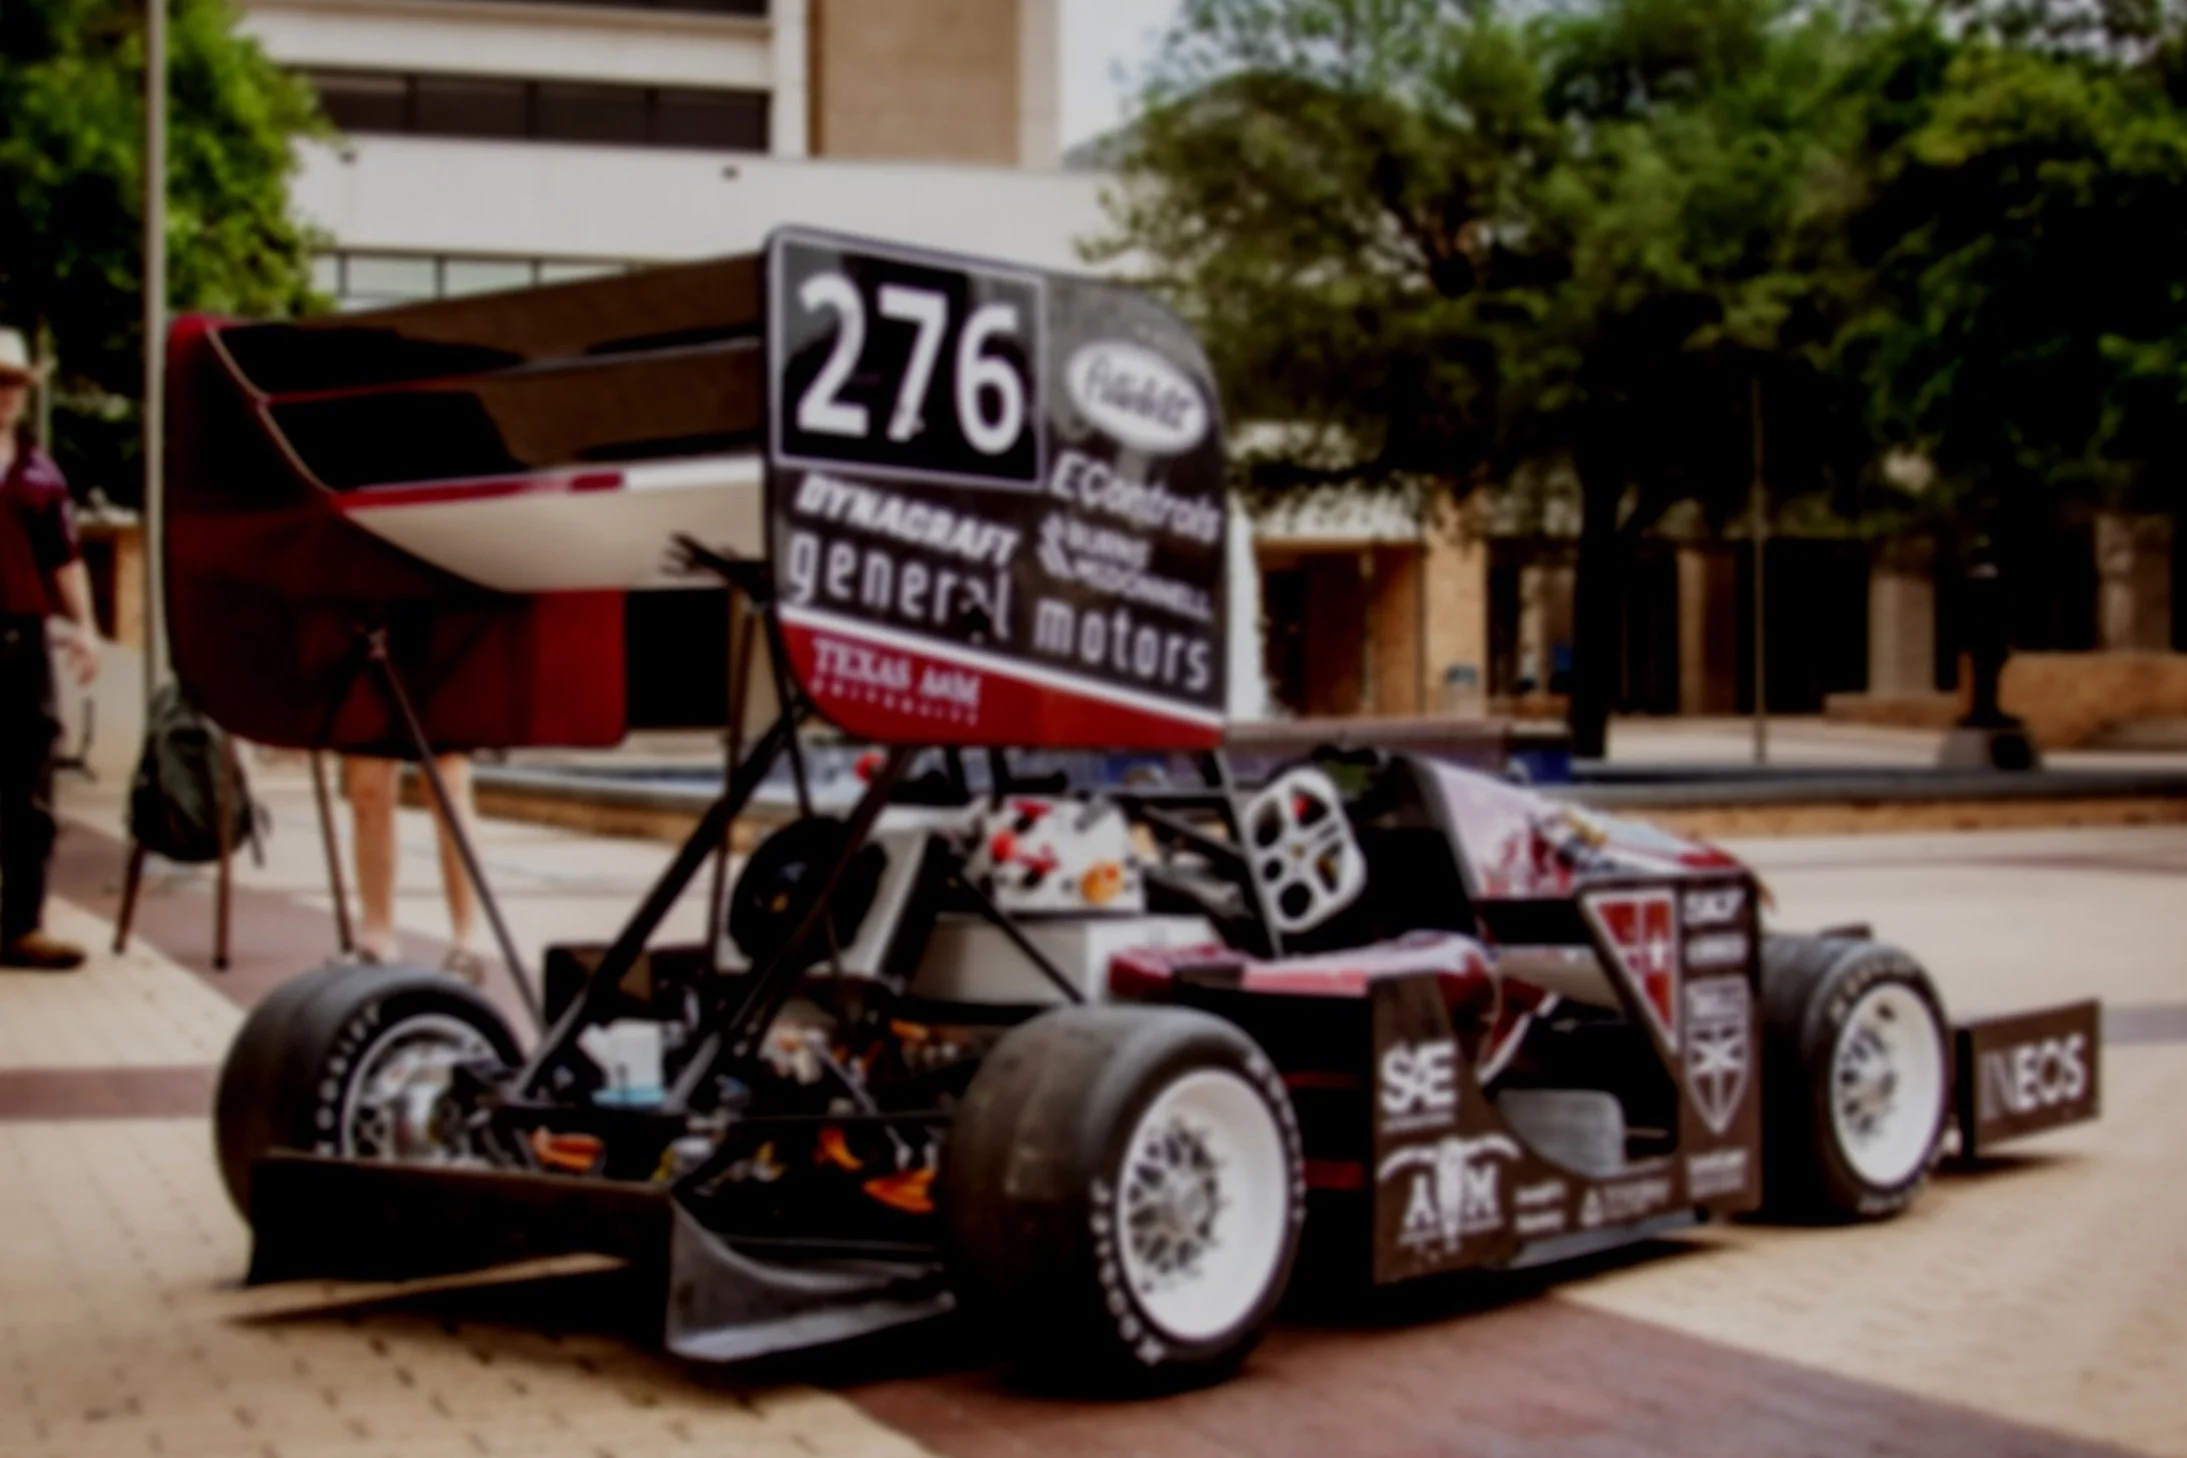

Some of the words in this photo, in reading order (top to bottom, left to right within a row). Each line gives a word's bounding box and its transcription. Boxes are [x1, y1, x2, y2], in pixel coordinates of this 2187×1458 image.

[798, 271, 1024, 456] 276
[796, 472, 1021, 567] DYNACRAFT
[813, 636, 911, 692] TEXAS
[1033, 597, 1210, 692] motors
